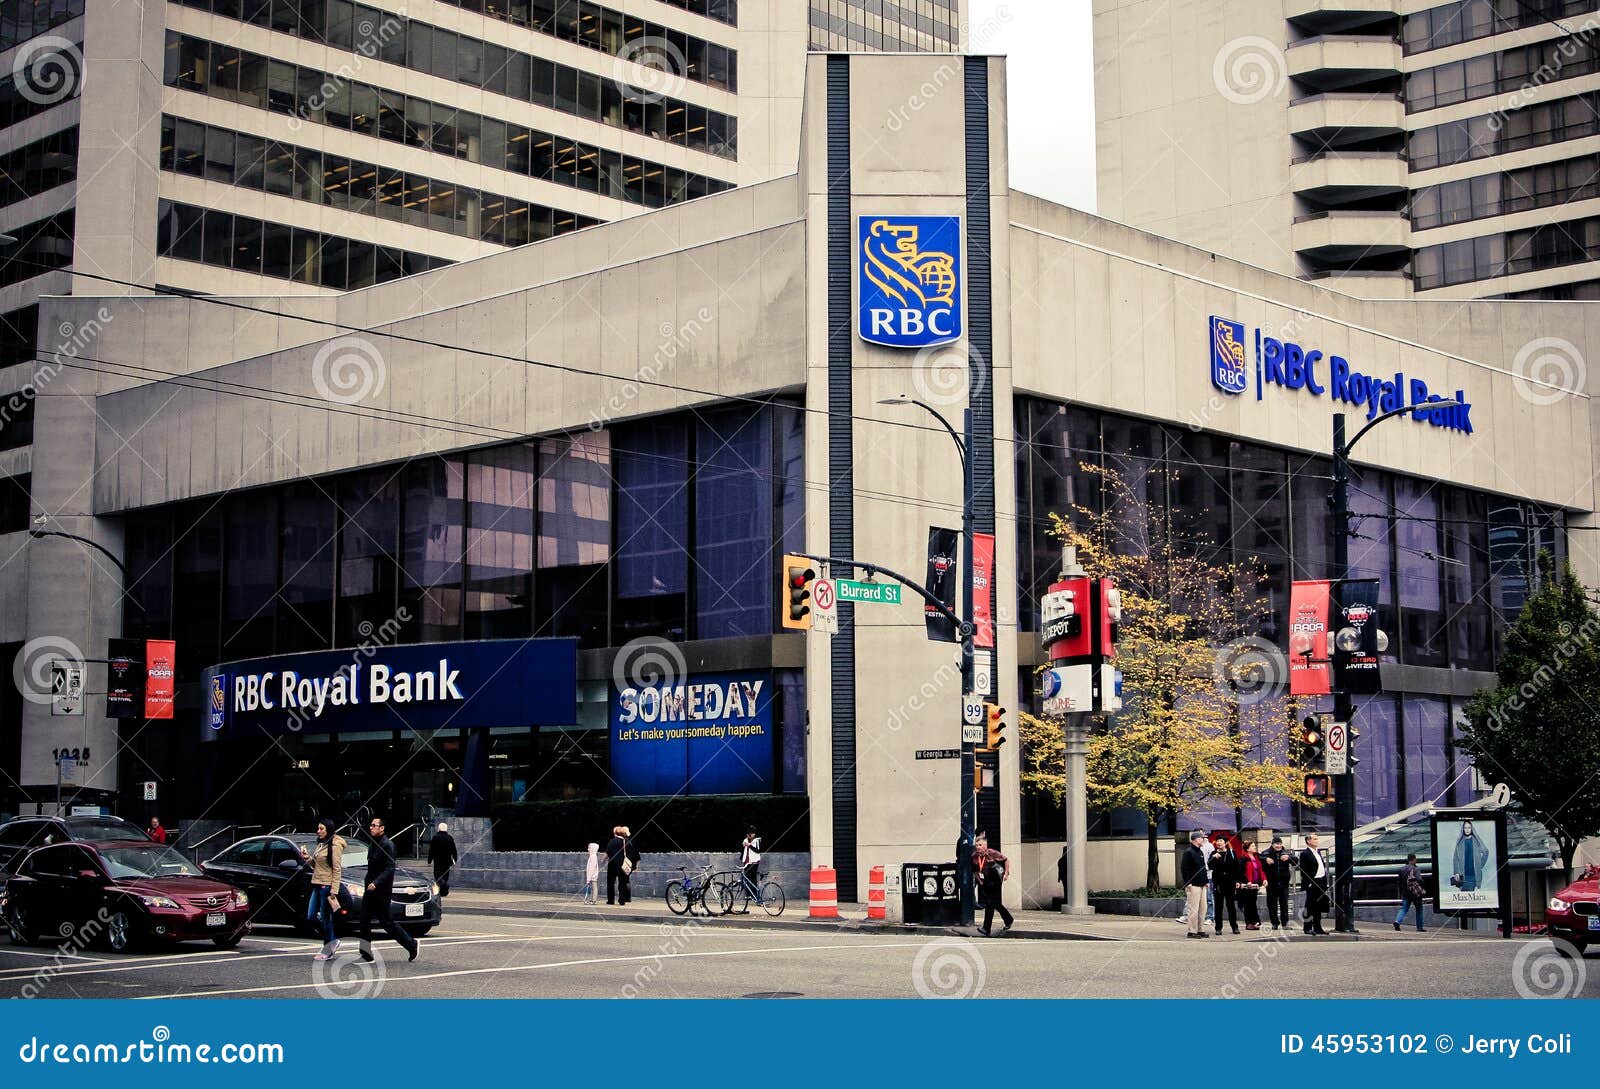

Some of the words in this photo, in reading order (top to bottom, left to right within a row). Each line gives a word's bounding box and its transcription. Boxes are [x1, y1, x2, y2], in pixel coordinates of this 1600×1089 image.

[869, 308, 952, 335] RBC
[1219, 367, 1244, 387] RBC
[1263, 336, 1325, 396] RBC
[1330, 355, 1406, 421] Royal
[841, 583, 880, 599] Burrard
[885, 587, 897, 601] St
[235, 671, 274, 713] RBC
[281, 664, 359, 718] Royal
[370, 659, 464, 704] Bank
[619, 680, 764, 723] SOMEDAY
[966, 704, 982, 717] 99
[619, 728, 640, 741] Let's
[641, 727, 664, 740] make
[727, 722, 764, 738] happen.
[964, 730, 982, 740] NORTH
[922, 750, 943, 760] Georgia
[1452, 893, 1486, 902] MaxMara
